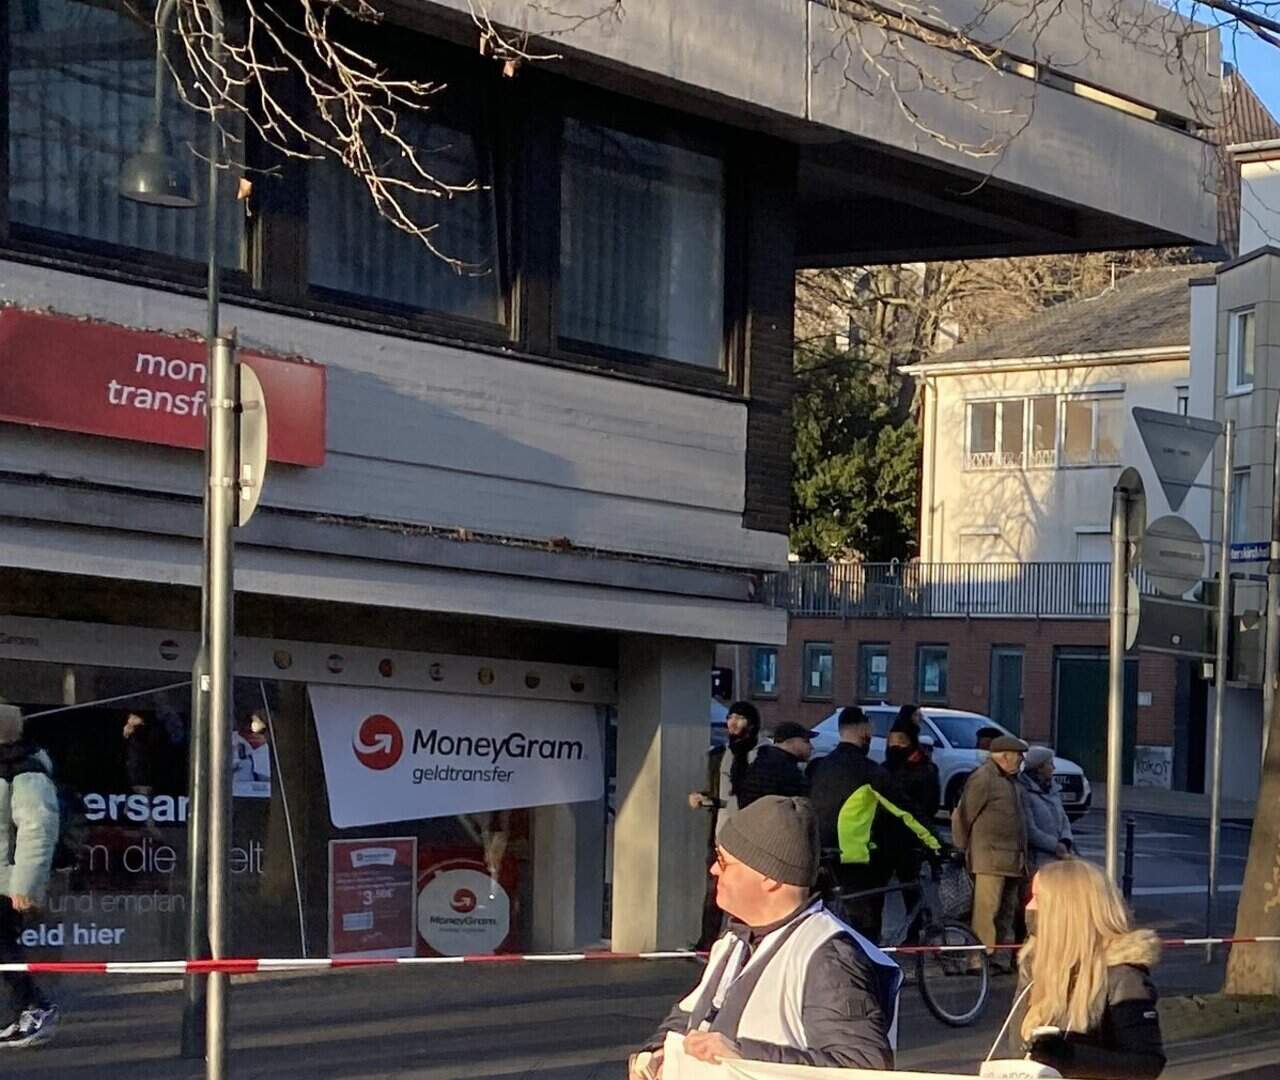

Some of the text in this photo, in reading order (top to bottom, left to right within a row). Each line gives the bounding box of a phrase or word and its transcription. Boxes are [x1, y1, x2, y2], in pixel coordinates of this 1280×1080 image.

[135, 352, 207, 384] mon
[107, 379, 208, 417] transf
[411, 727, 584, 764] MoneyGram
[412, 765, 515, 785] geldtransfer
[123, 837, 177, 873] die
[229, 839, 265, 874] elt
[17, 923, 125, 947] eld hier
[430, 915, 497, 927] MoneyGram
